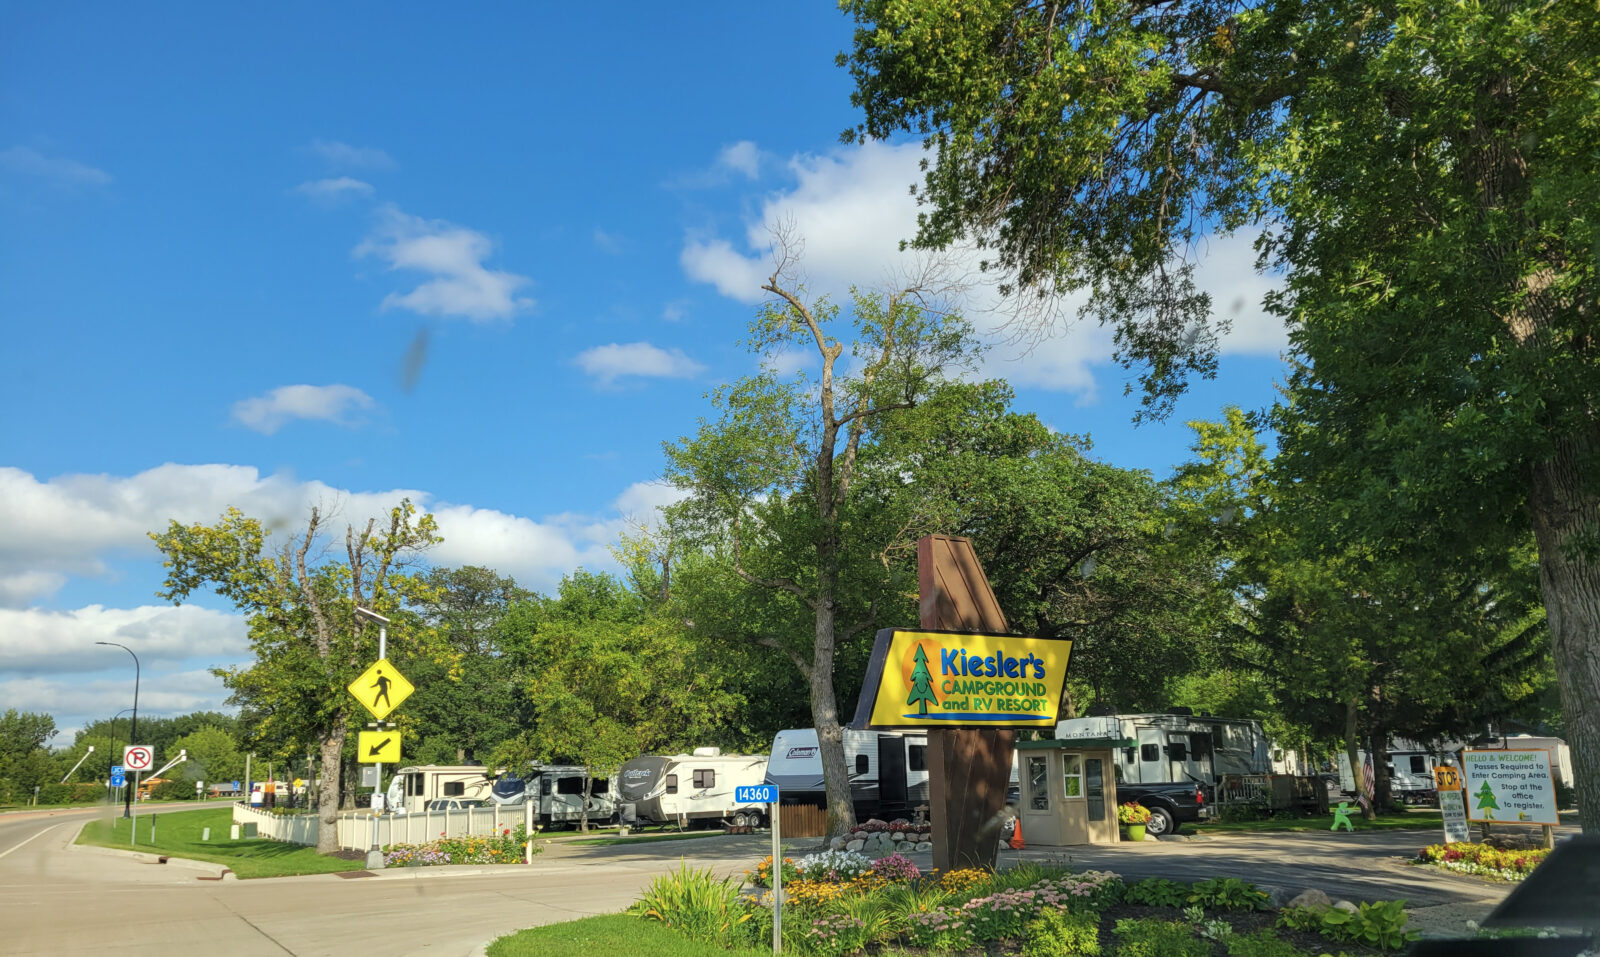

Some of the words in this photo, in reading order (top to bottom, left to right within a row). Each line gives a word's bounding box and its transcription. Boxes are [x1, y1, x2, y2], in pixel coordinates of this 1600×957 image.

[940, 647, 1046, 679] Kiesler's
[941, 679, 1047, 697] CAMPGROUND
[942, 696, 969, 711] and
[973, 697, 993, 711] RV
[997, 698, 1048, 712] RESORT
[133, 751, 145, 764] P
[787, 746, 818, 759] Coleman
[1465, 754, 1487, 762] HELLO
[1498, 754, 1537, 762] WELCOME!
[1500, 763, 1534, 771] Required
[1437, 771, 1457, 785] STOP
[1491, 772, 1526, 780] Camping
[1501, 783, 1518, 791] Stop
[1529, 783, 1543, 791] the
[738, 787, 770, 801] 14360
[1511, 792, 1534, 800] office
[1513, 802, 1545, 810] register.
